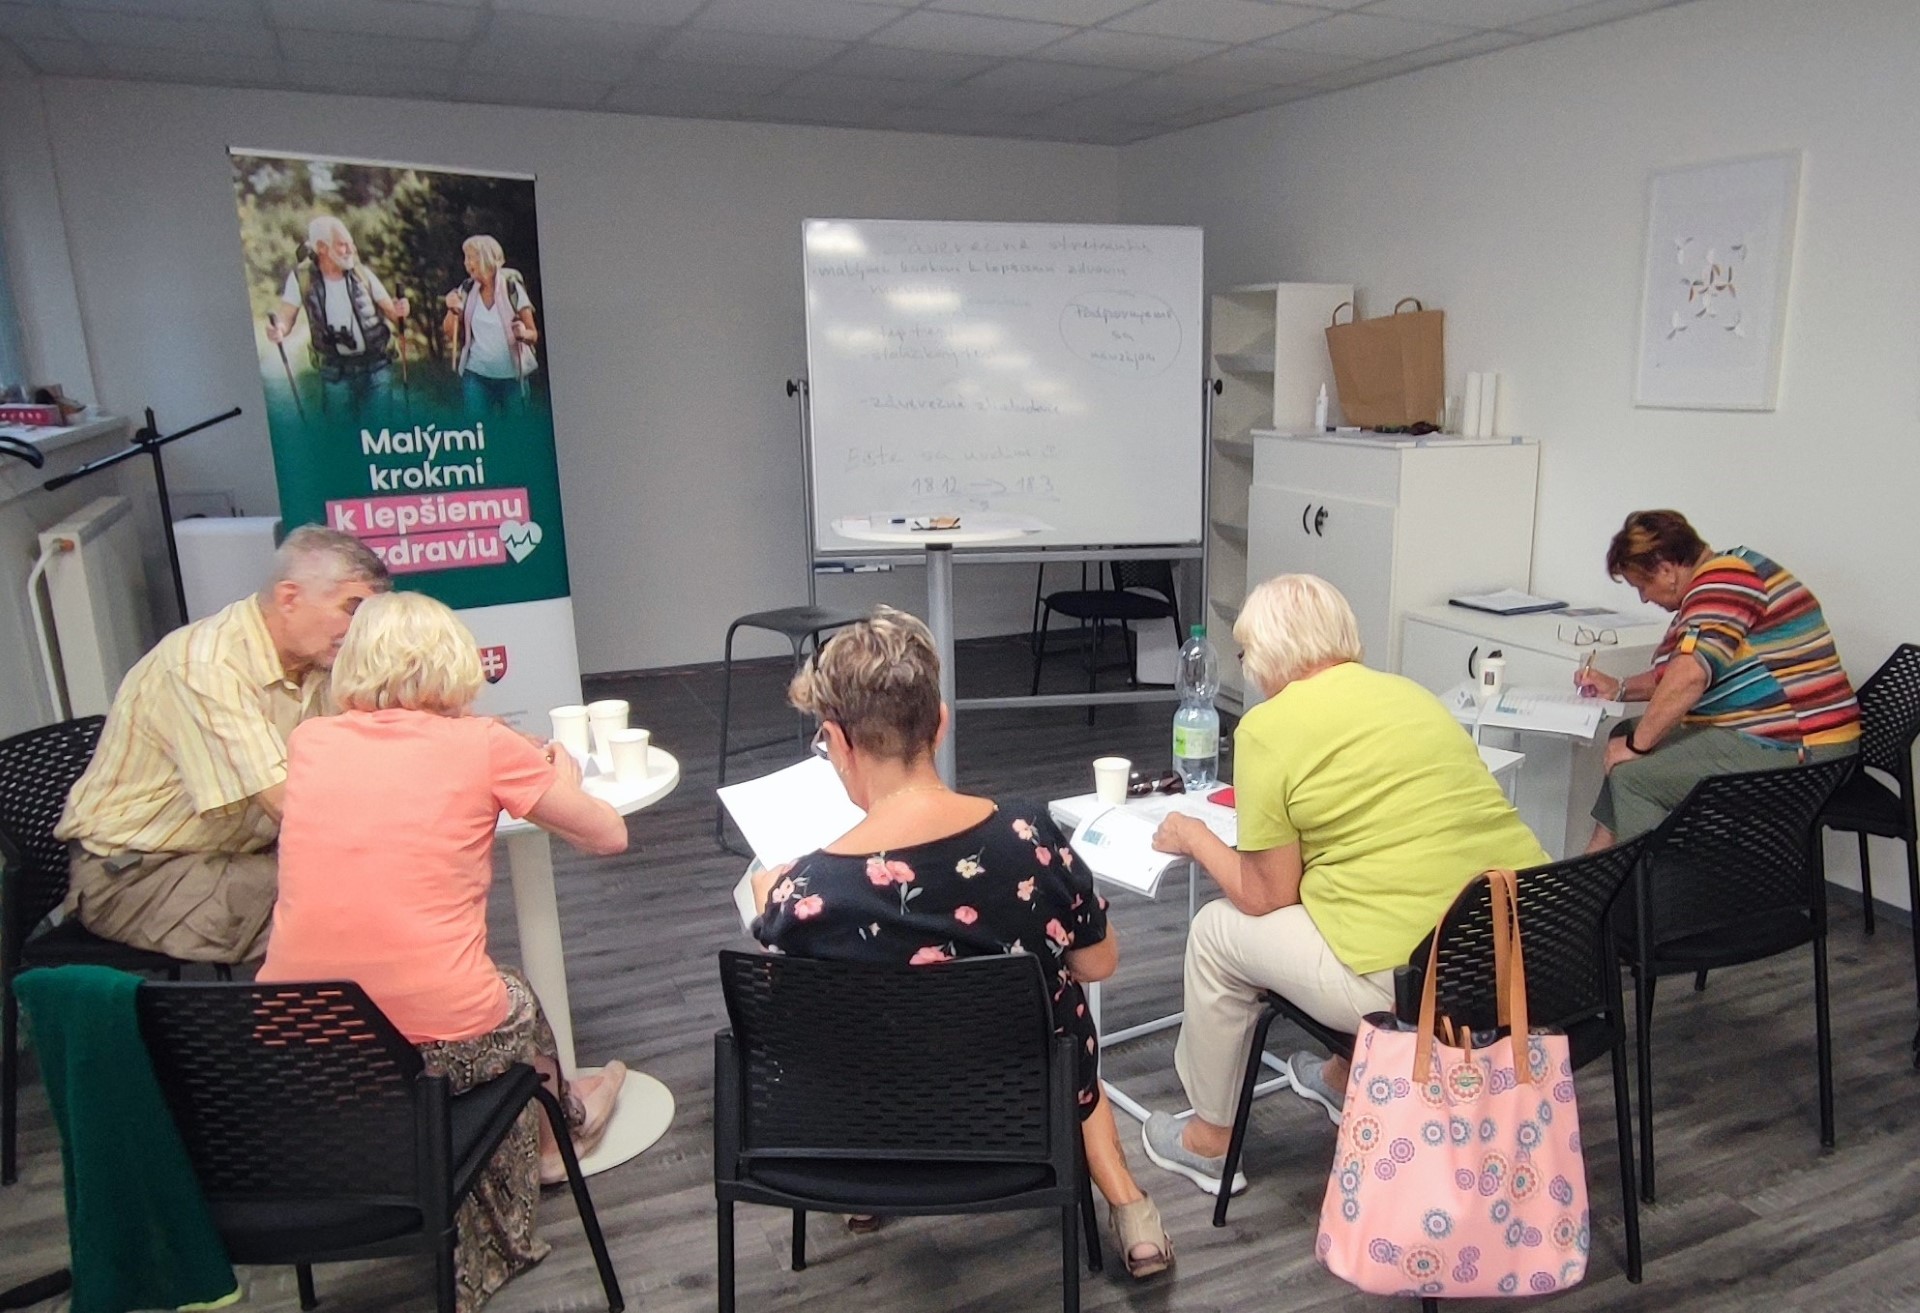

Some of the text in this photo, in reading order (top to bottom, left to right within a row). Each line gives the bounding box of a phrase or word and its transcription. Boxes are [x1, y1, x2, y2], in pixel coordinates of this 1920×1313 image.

[360, 421, 485, 461] Malými
[368, 457, 485, 491] krokmi
[333, 495, 523, 535] k lepšiemu
